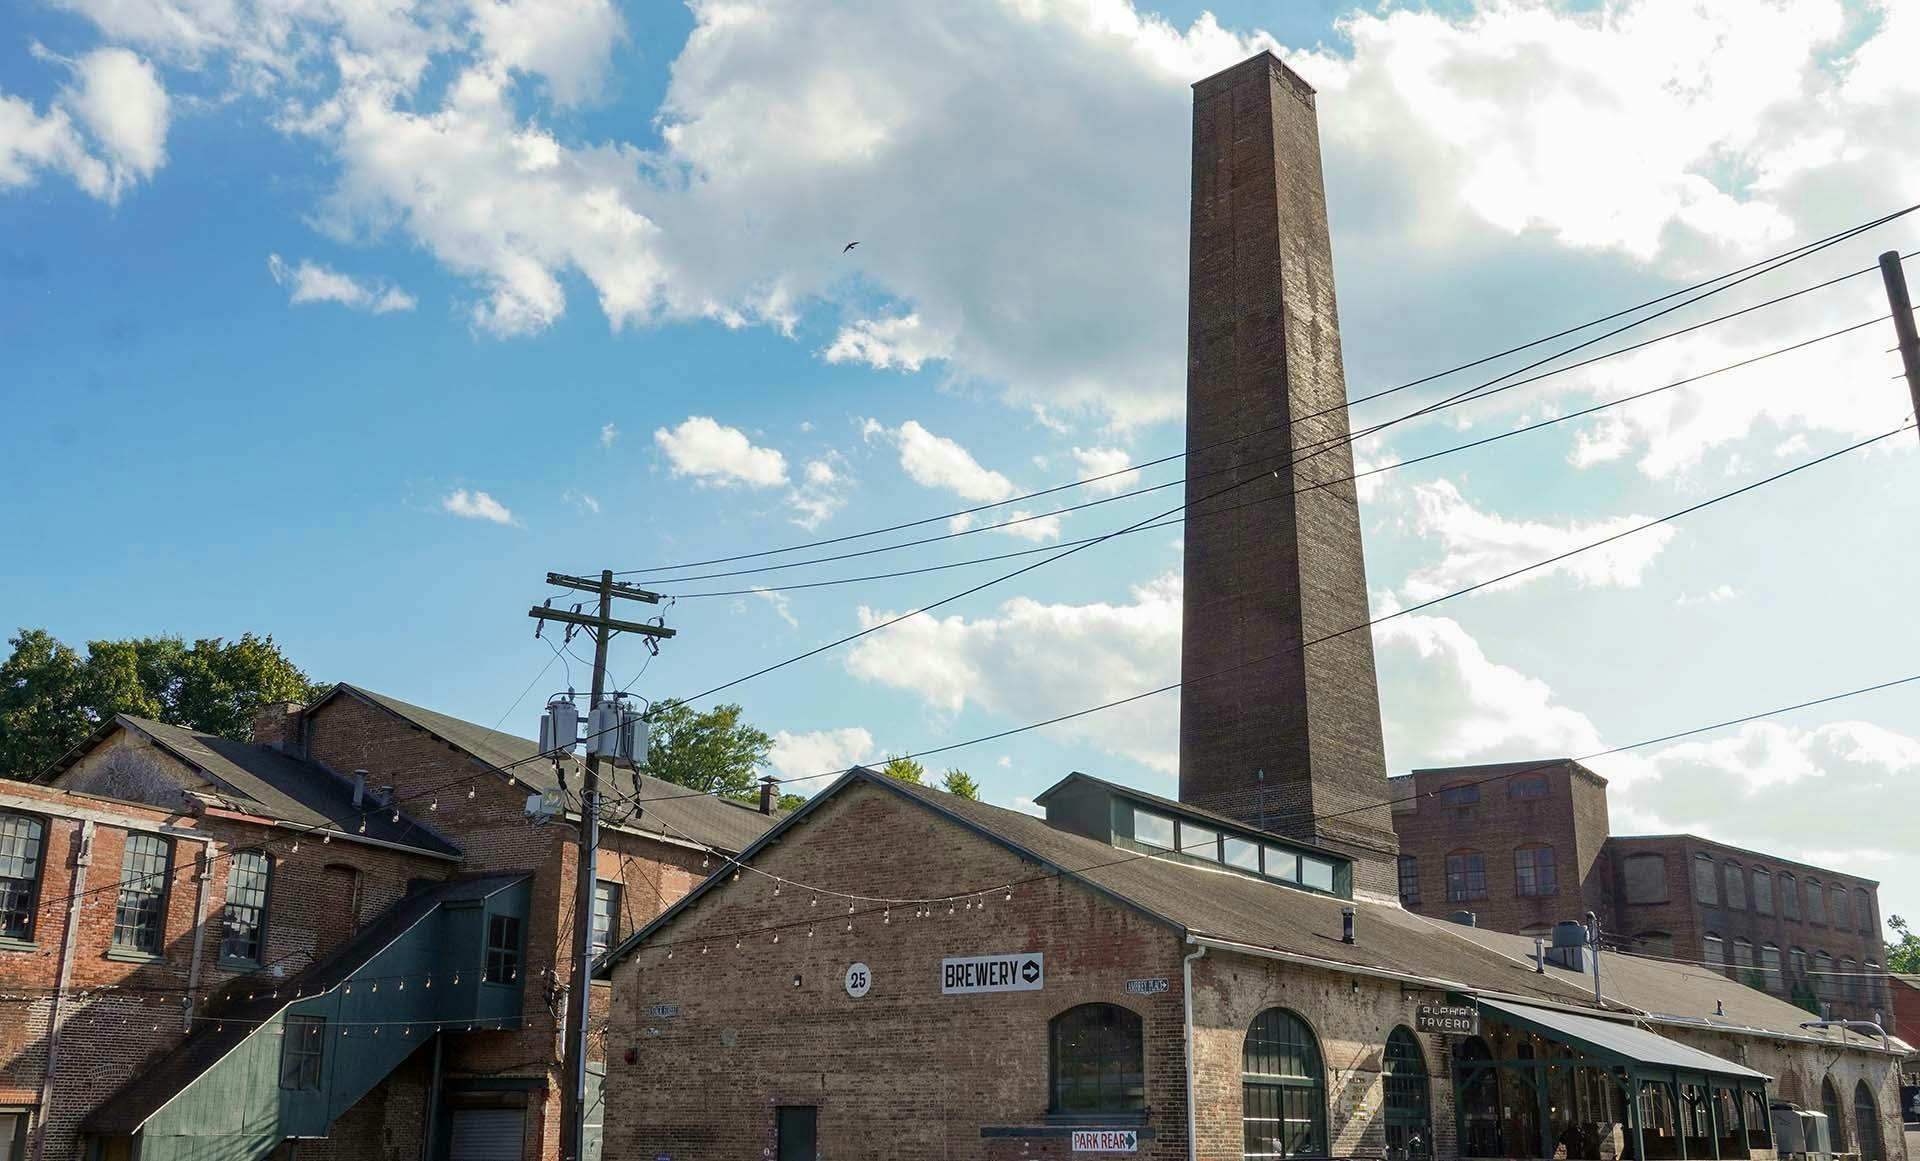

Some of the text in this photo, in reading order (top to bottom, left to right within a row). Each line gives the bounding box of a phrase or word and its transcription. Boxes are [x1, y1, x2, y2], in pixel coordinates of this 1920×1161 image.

[851, 972, 866, 989] 25
[945, 961, 1019, 988] BREWERY
[1422, 1006, 1467, 1016] ALPHA
[1419, 1016, 1470, 1029] TAVERN
[1074, 1133, 1126, 1149] PARK REAR
